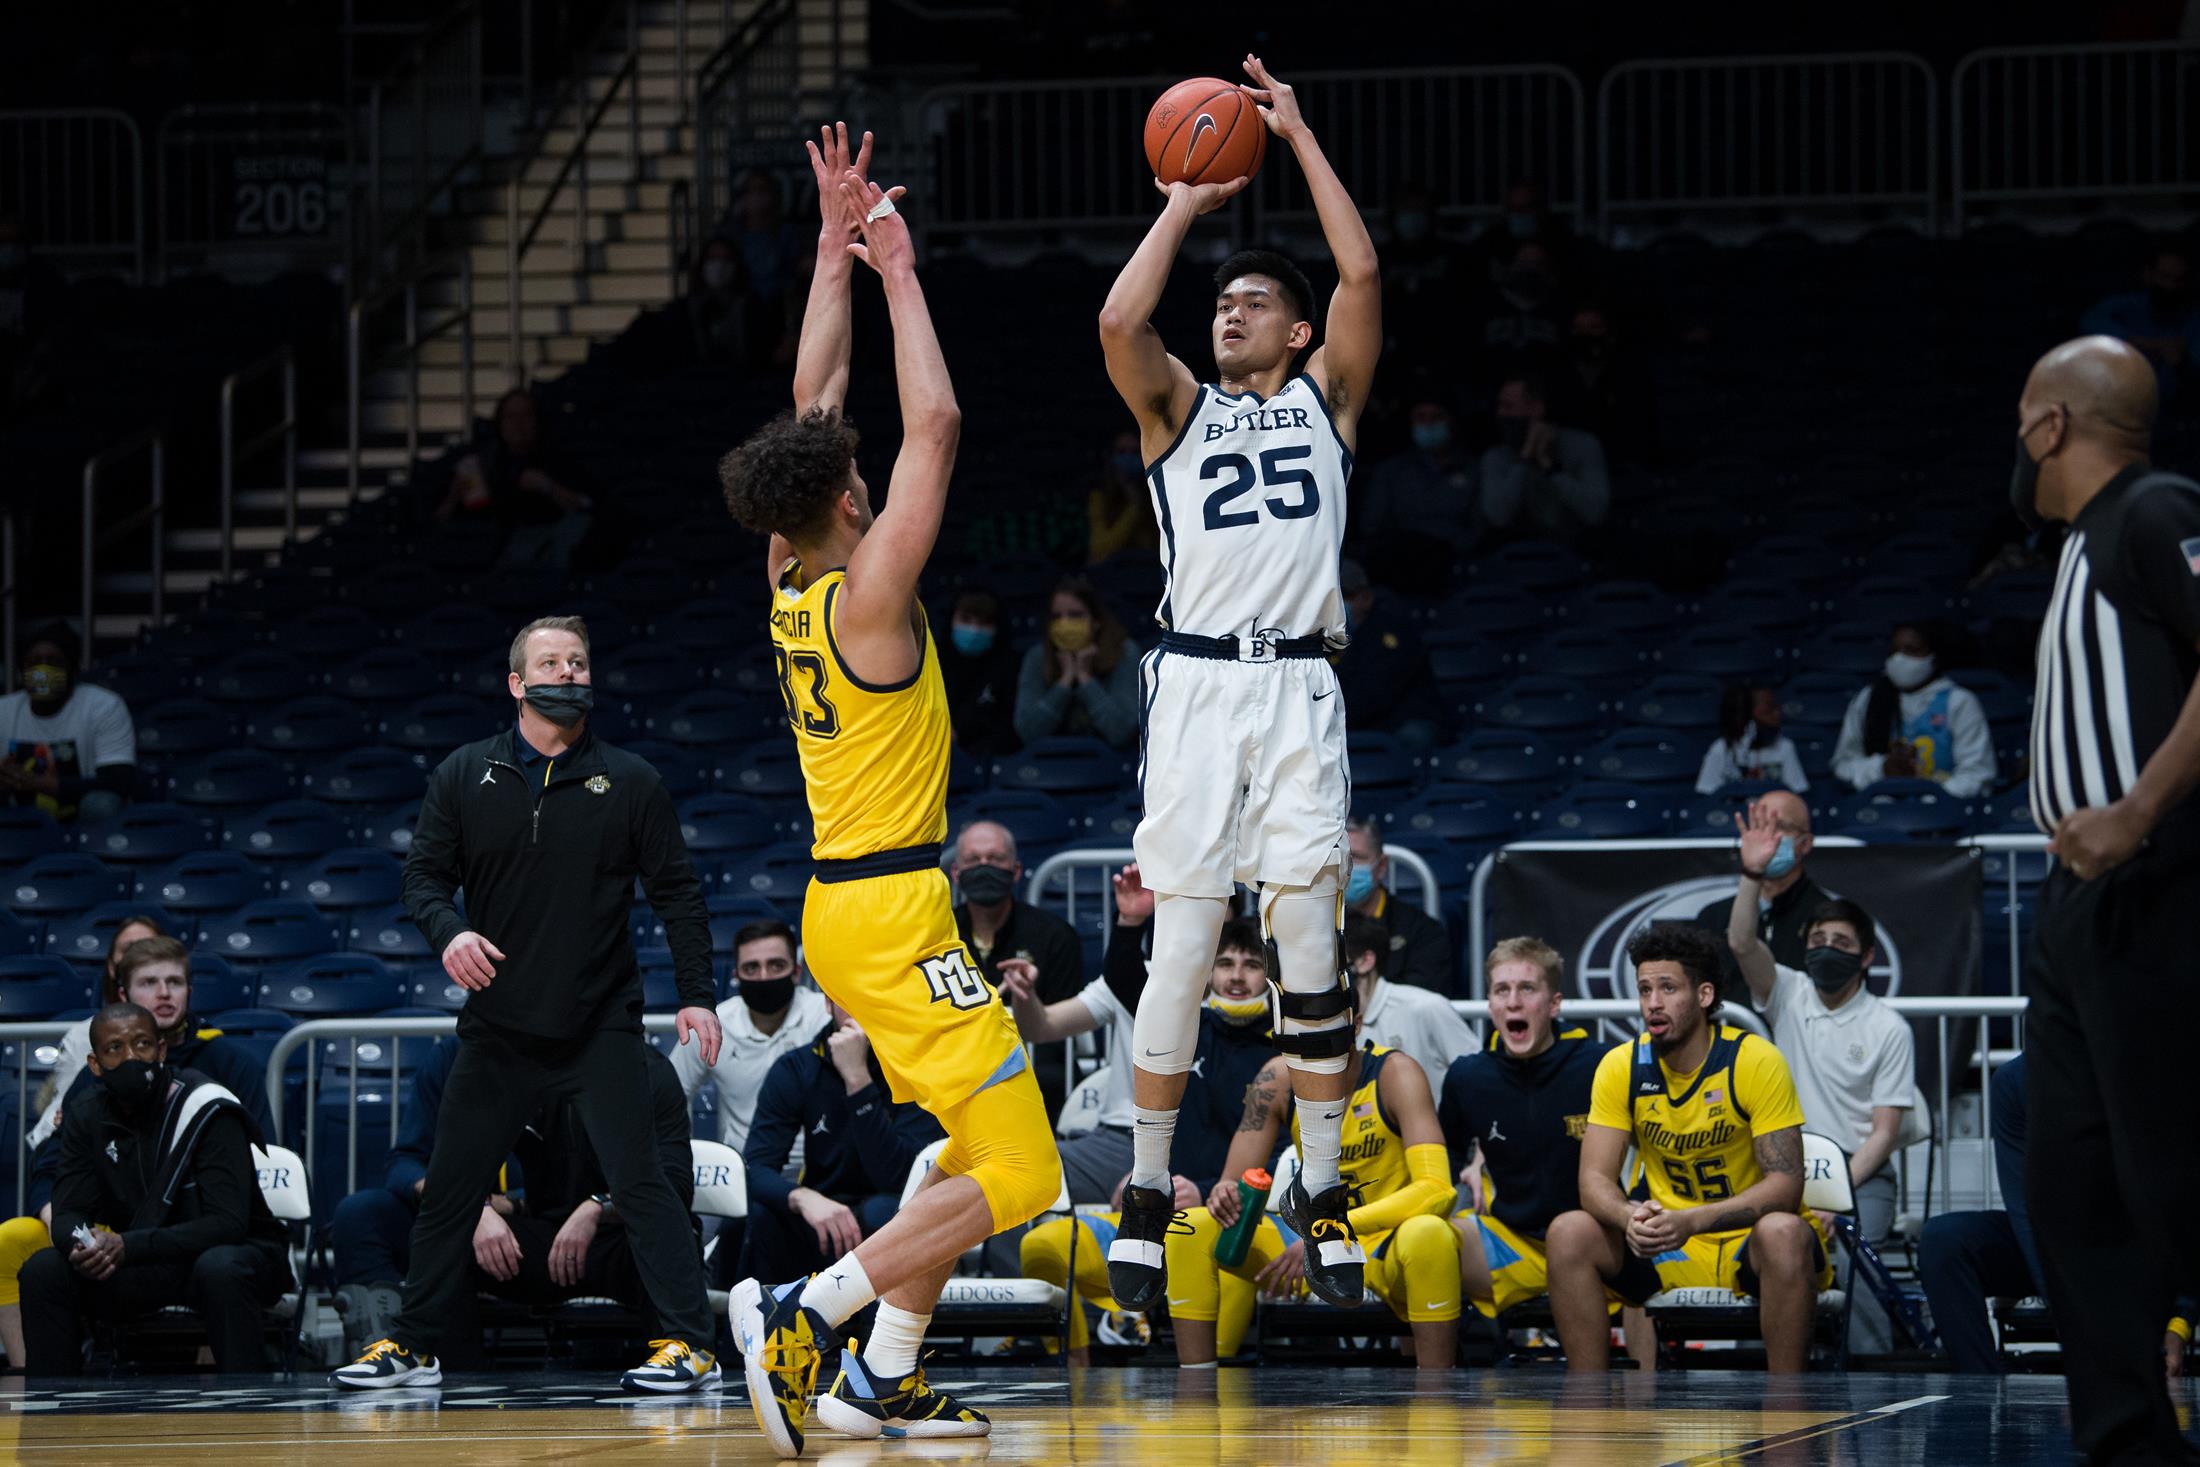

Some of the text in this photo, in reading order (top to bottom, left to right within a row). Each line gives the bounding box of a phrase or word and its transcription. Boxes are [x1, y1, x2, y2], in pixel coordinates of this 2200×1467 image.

[234, 181, 326, 233] 206
[1204, 408, 1312, 443] BUTLER
[1199, 444, 1320, 531] 25
[1251, 640, 1265, 657] B
[913, 948, 992, 1011] MU
[1082, 1088, 1099, 1109] B
[1641, 1119, 1735, 1155] Marquette
[1662, 1155, 1734, 1201] 55
